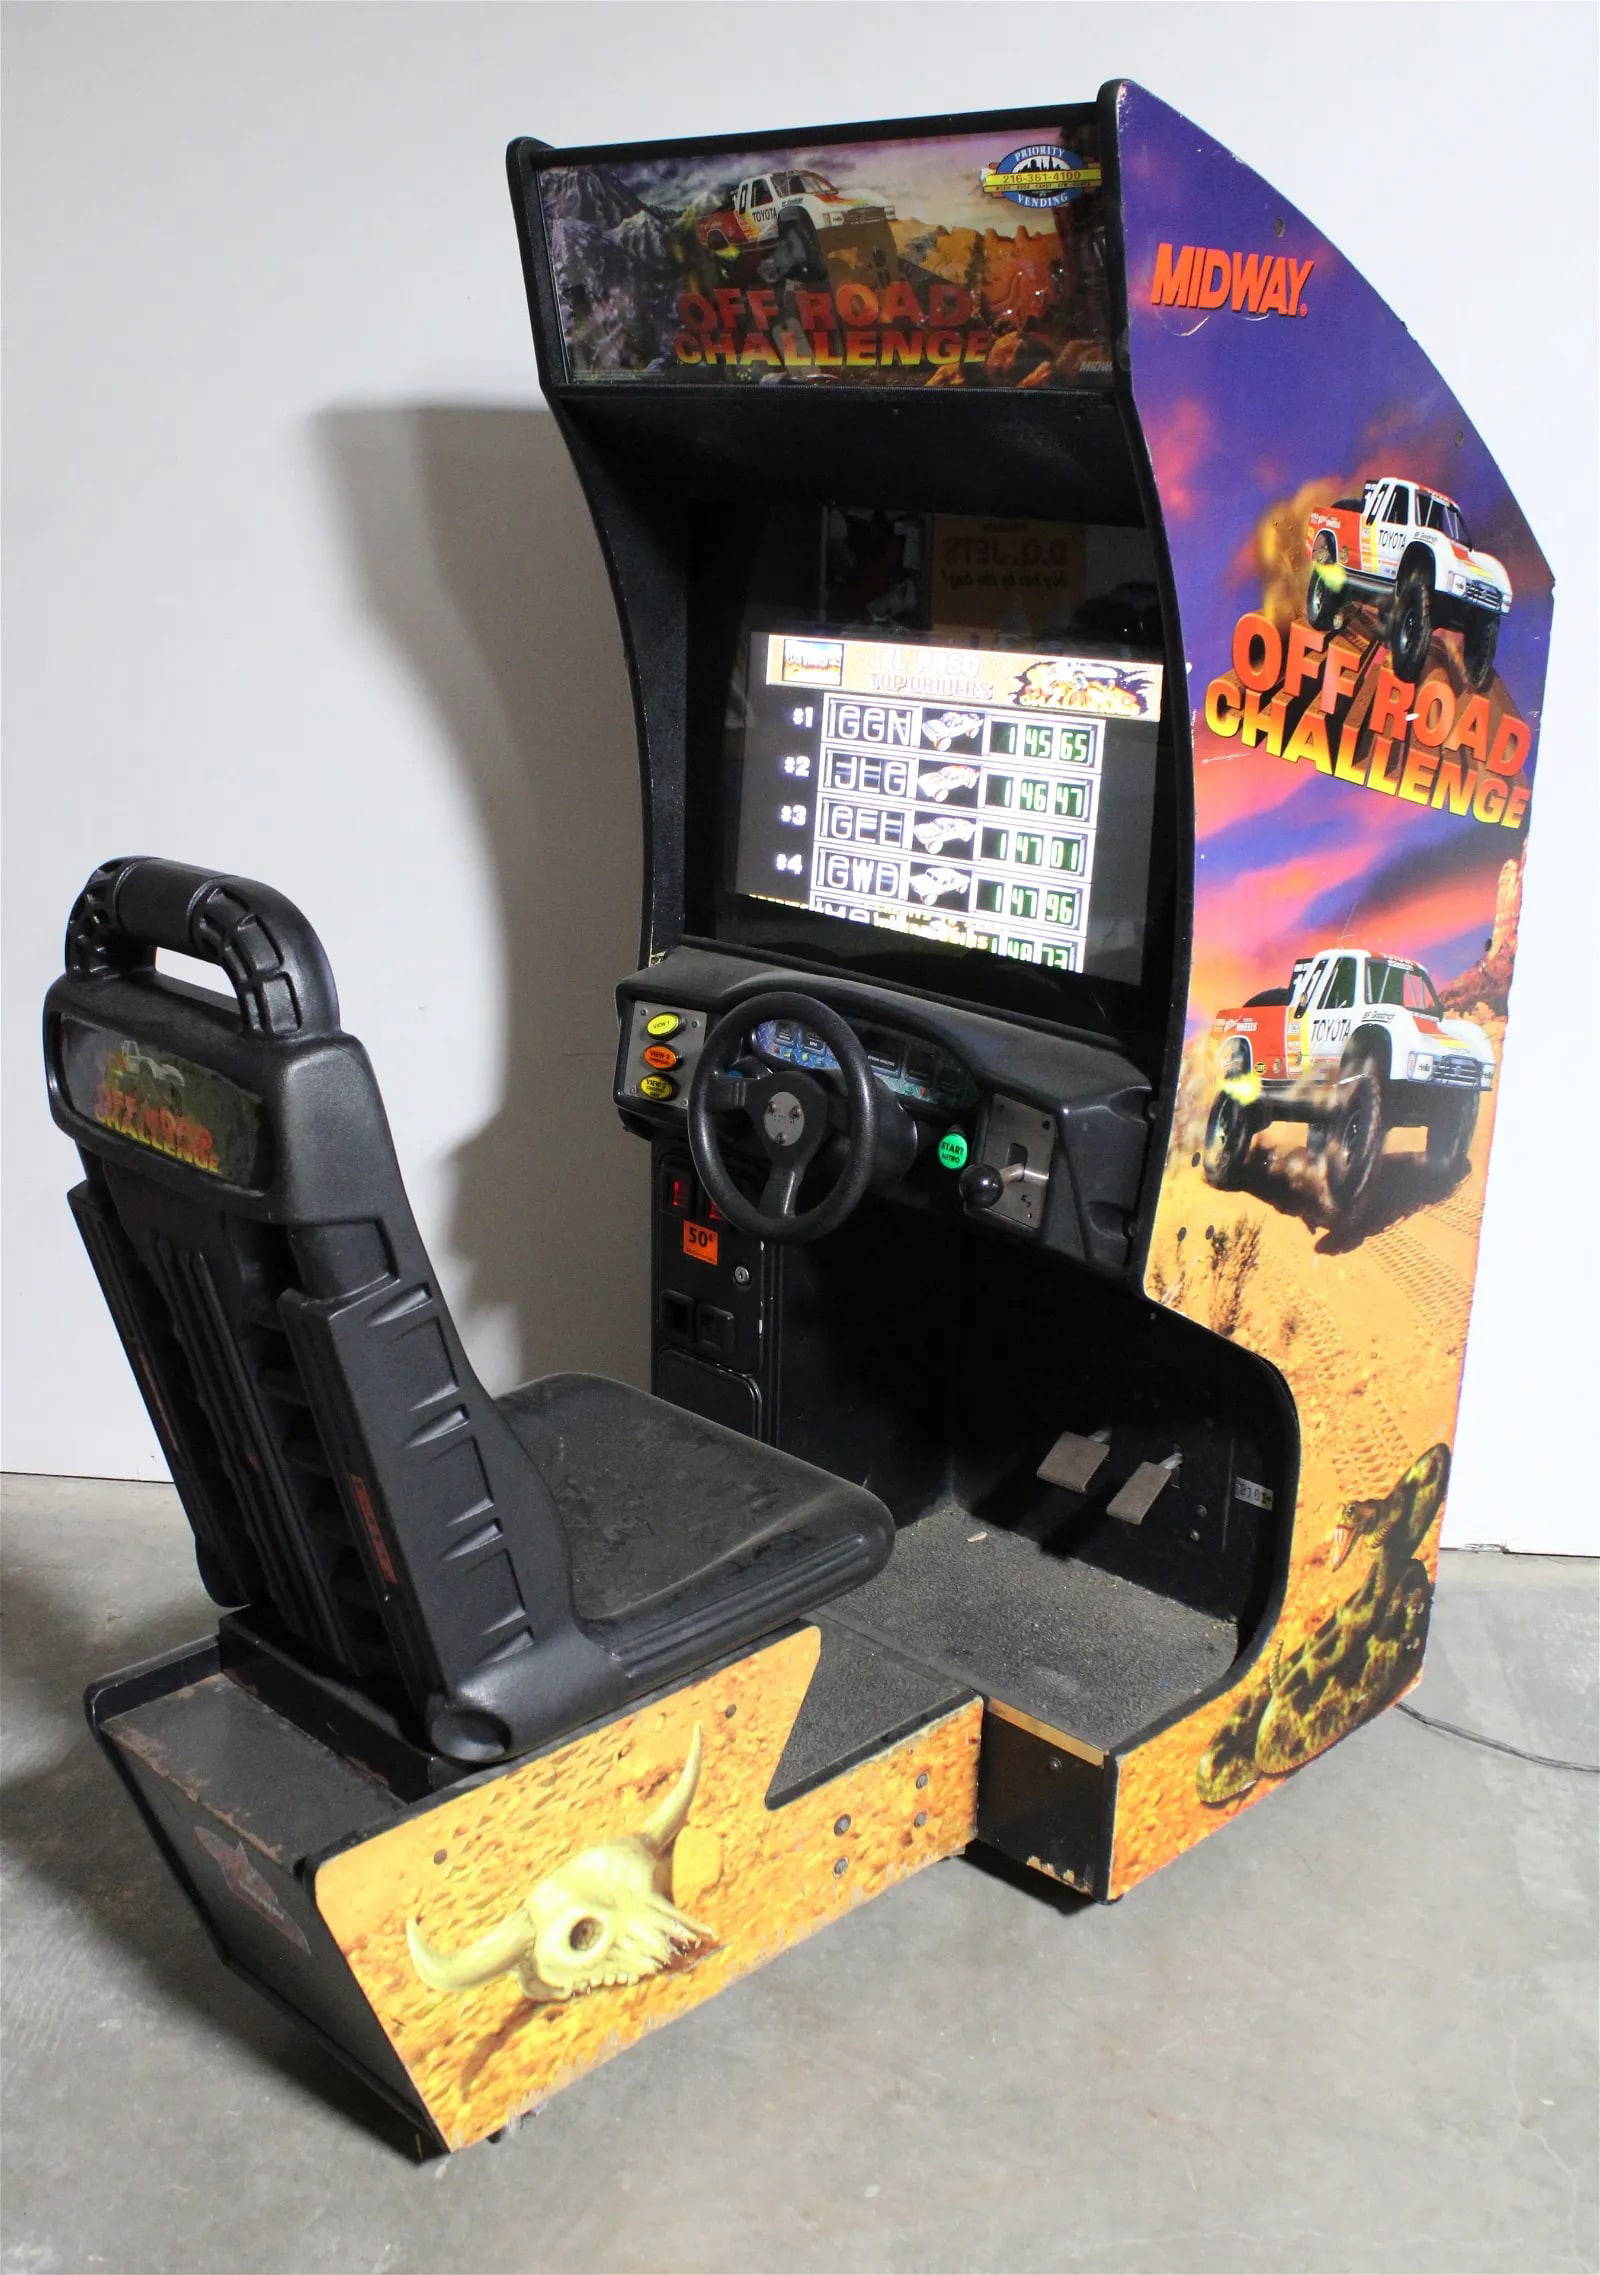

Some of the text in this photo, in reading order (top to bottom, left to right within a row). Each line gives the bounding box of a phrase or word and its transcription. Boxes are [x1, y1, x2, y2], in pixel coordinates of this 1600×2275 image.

[1014, 145, 1065, 161] PRIORITY
[1002, 171, 1081, 184] 216-361-4100
[1018, 192, 1068, 207] VENDING
[752, 207, 777, 224] TOYOTA
[1151, 242, 1315, 317] MIDWAY
[676, 281, 973, 330] OFF ROAD
[672, 330, 993, 367] CHALLENGE
[1378, 529, 1407, 550] TOYOTA
[871, 673, 994, 700] TOP DRIVERS
[1232, 612, 1533, 778] OFF ROAD
[838, 704, 912, 746] GGN
[1025, 728, 1052, 758] 45
[1060, 731, 1088, 762] 65
[1204, 679, 1533, 830] CHALLENGE
[1020, 781, 1048, 811] 46
[1055, 785, 1083, 817] 47
[1016, 835, 1042, 866] 47
[1011, 888, 1038, 919] 47
[1045, 893, 1073, 925] 96
[1311, 1018, 1351, 1043] TOYOTA
[650, 1051, 665, 1059] VIEW
[941, 1141, 965, 1155] START
